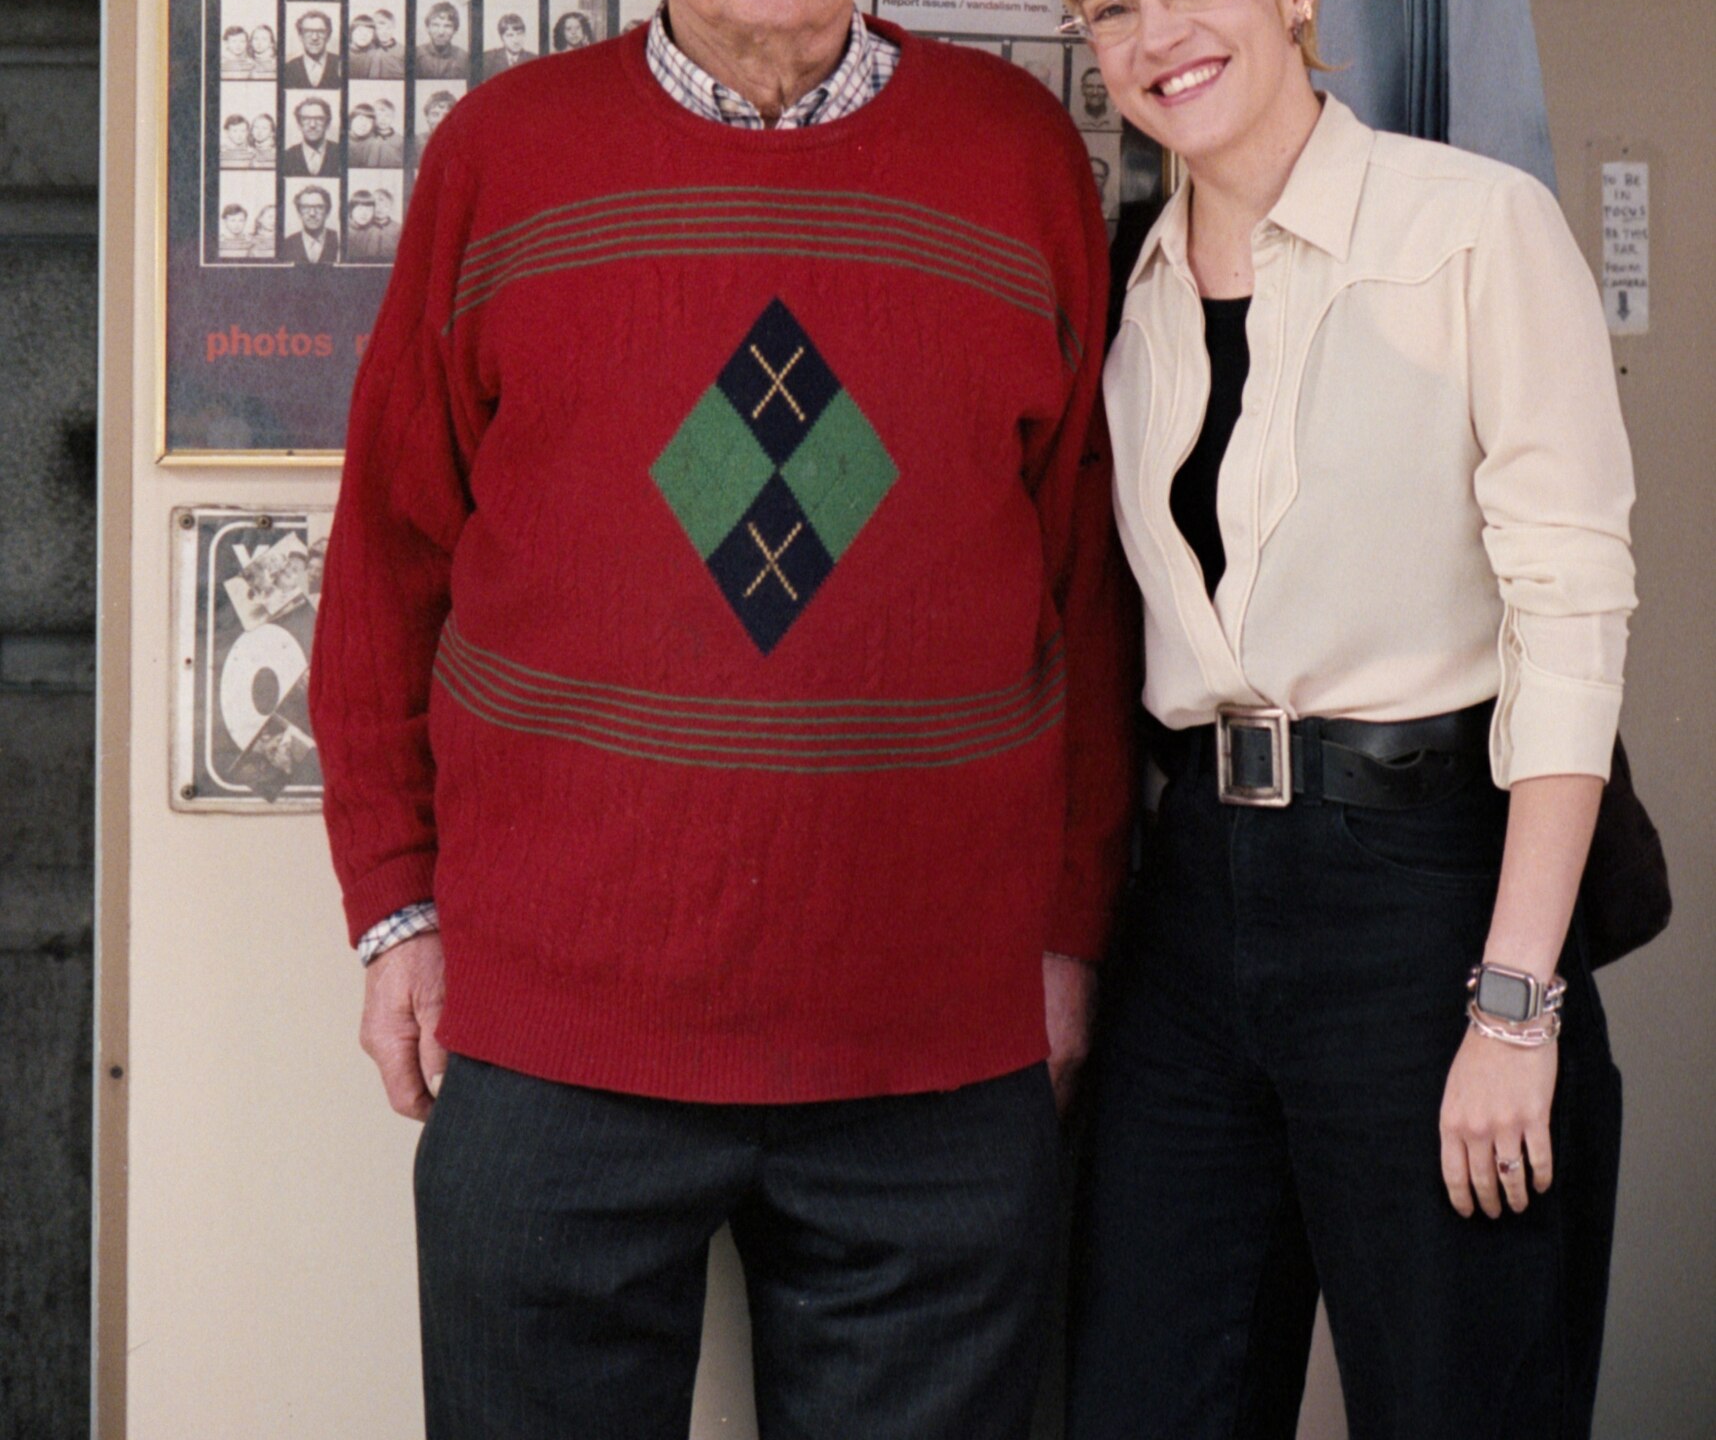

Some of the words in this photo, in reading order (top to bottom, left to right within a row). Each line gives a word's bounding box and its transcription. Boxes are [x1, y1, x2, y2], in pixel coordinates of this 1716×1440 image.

[966, 1, 1022, 12] vandalism
[1023, 3, 1050, 14] here.
[206, 323, 334, 363] photos
